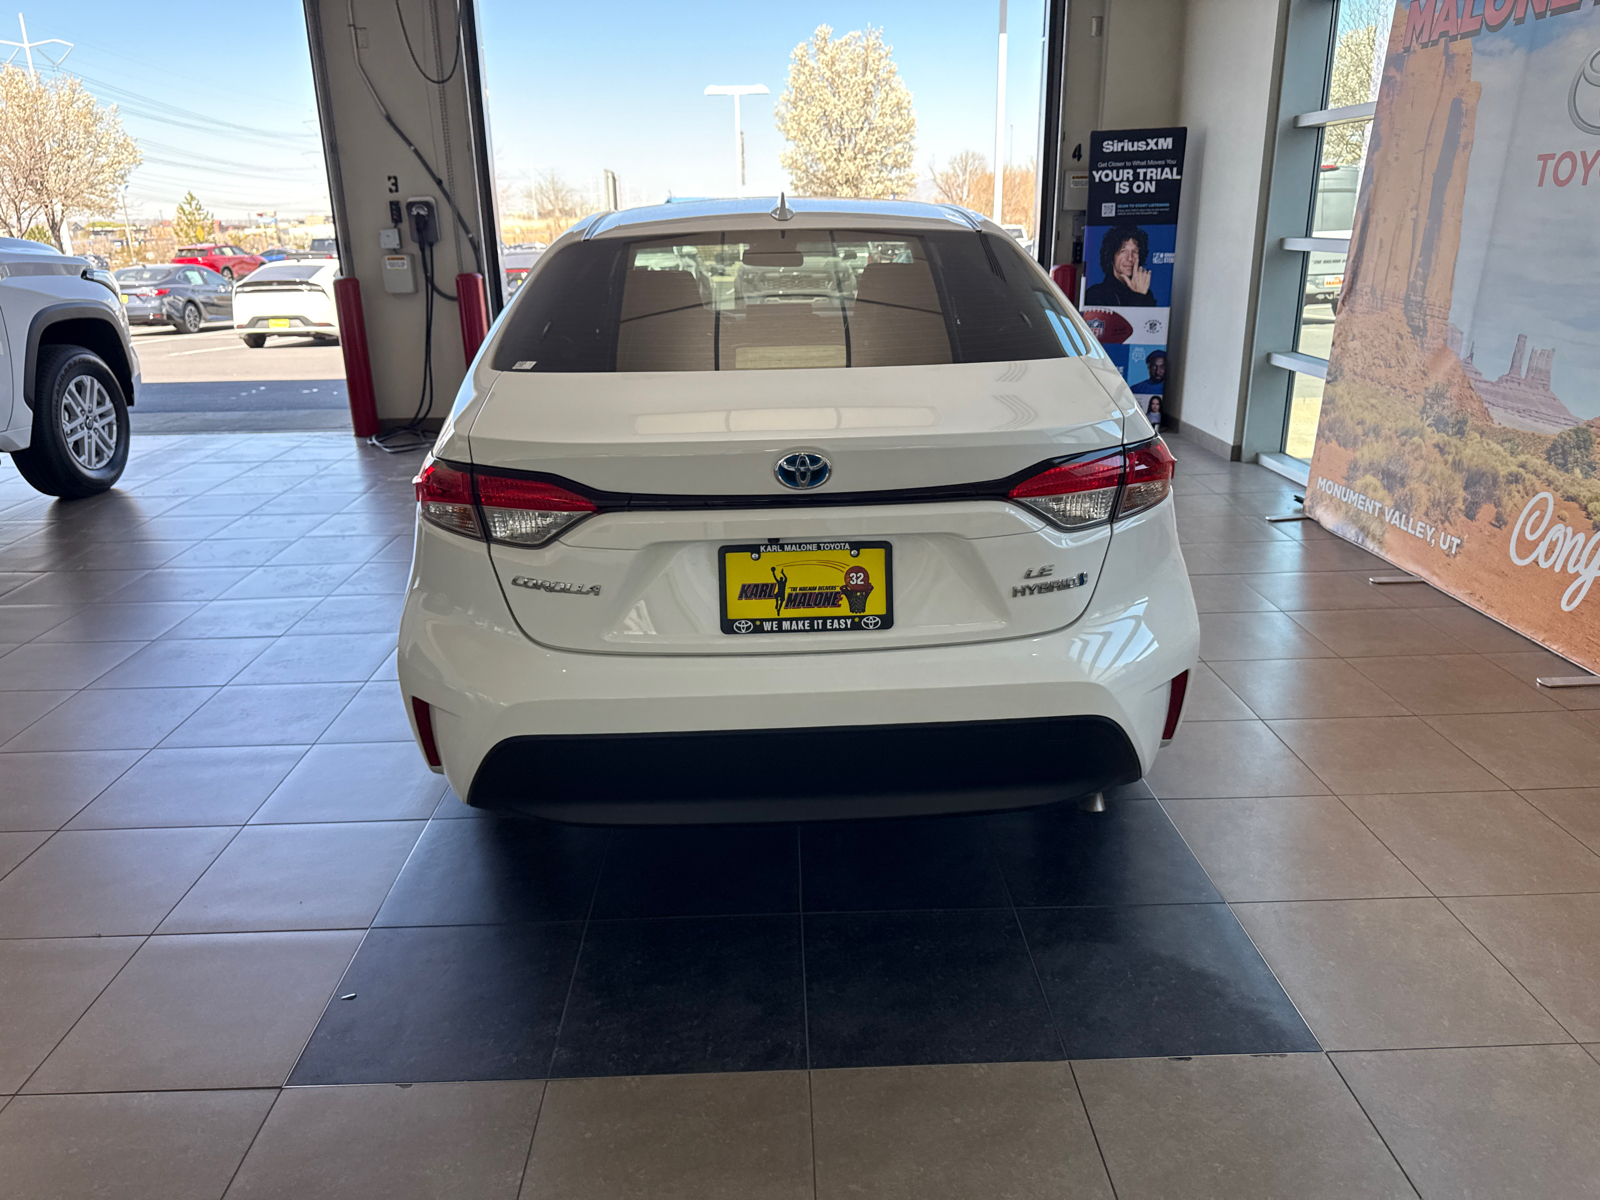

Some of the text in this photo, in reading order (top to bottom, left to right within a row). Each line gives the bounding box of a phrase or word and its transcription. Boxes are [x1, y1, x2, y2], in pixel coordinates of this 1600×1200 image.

[1402, 0, 1582, 52] MALO
[1072, 143, 1082, 162] 4
[1102, 137, 1173, 153] SiriusXM
[1092, 168, 1134, 183] YOUR
[1136, 167, 1181, 181] TRIAL
[1537, 149, 1600, 188] TOY
[387, 175, 399, 193] 3
[1115, 180, 1156, 194] IS ON
[1317, 476, 1461, 554] MONUMENT VALLEY, UT
[784, 543, 818, 552] MALONE
[820, 542, 850, 551] TOYOTA
[849, 572, 865, 585] 32
[1023, 564, 1054, 579] LE
[511, 575, 601, 596] COROLLA
[738, 583, 777, 601] KARL
[1012, 576, 1078, 598] HYBRID
[784, 591, 843, 609] MALONE
[763, 619, 852, 631] WE MAKE IT EASY
